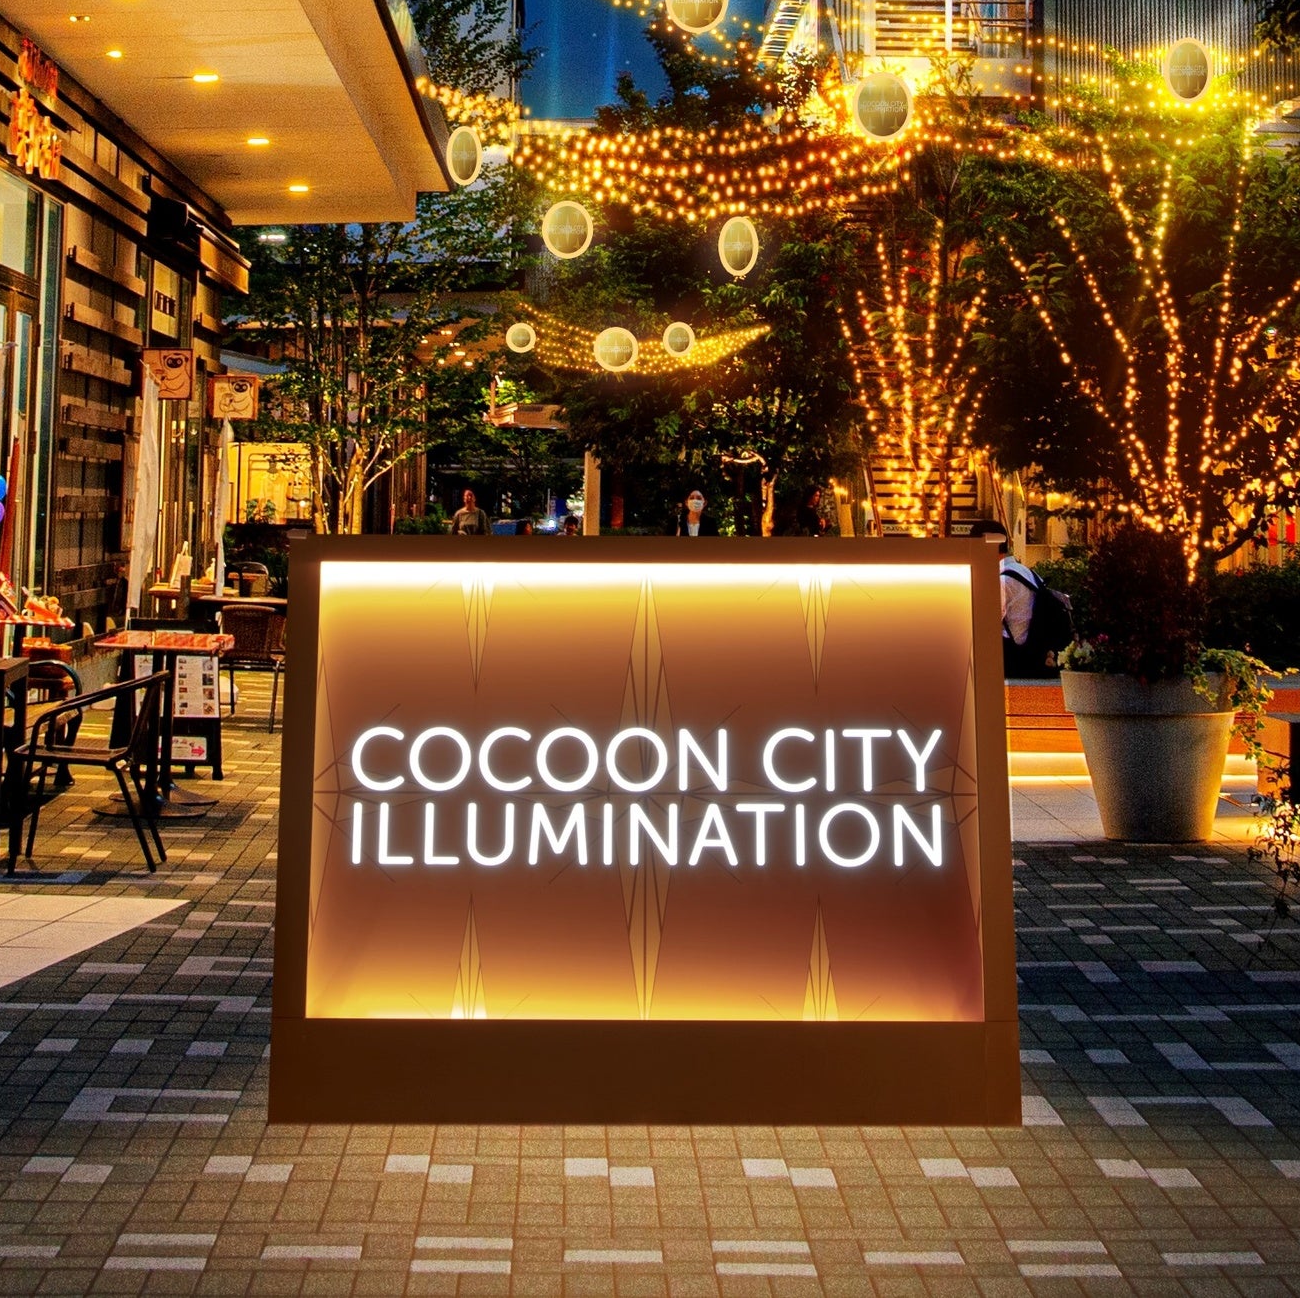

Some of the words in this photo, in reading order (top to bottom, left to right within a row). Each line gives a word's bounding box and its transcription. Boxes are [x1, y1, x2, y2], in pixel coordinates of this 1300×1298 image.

[349, 725, 729, 793] COCOON
[762, 725, 943, 793] CITY
[349, 801, 944, 867] ILLUMINATION
